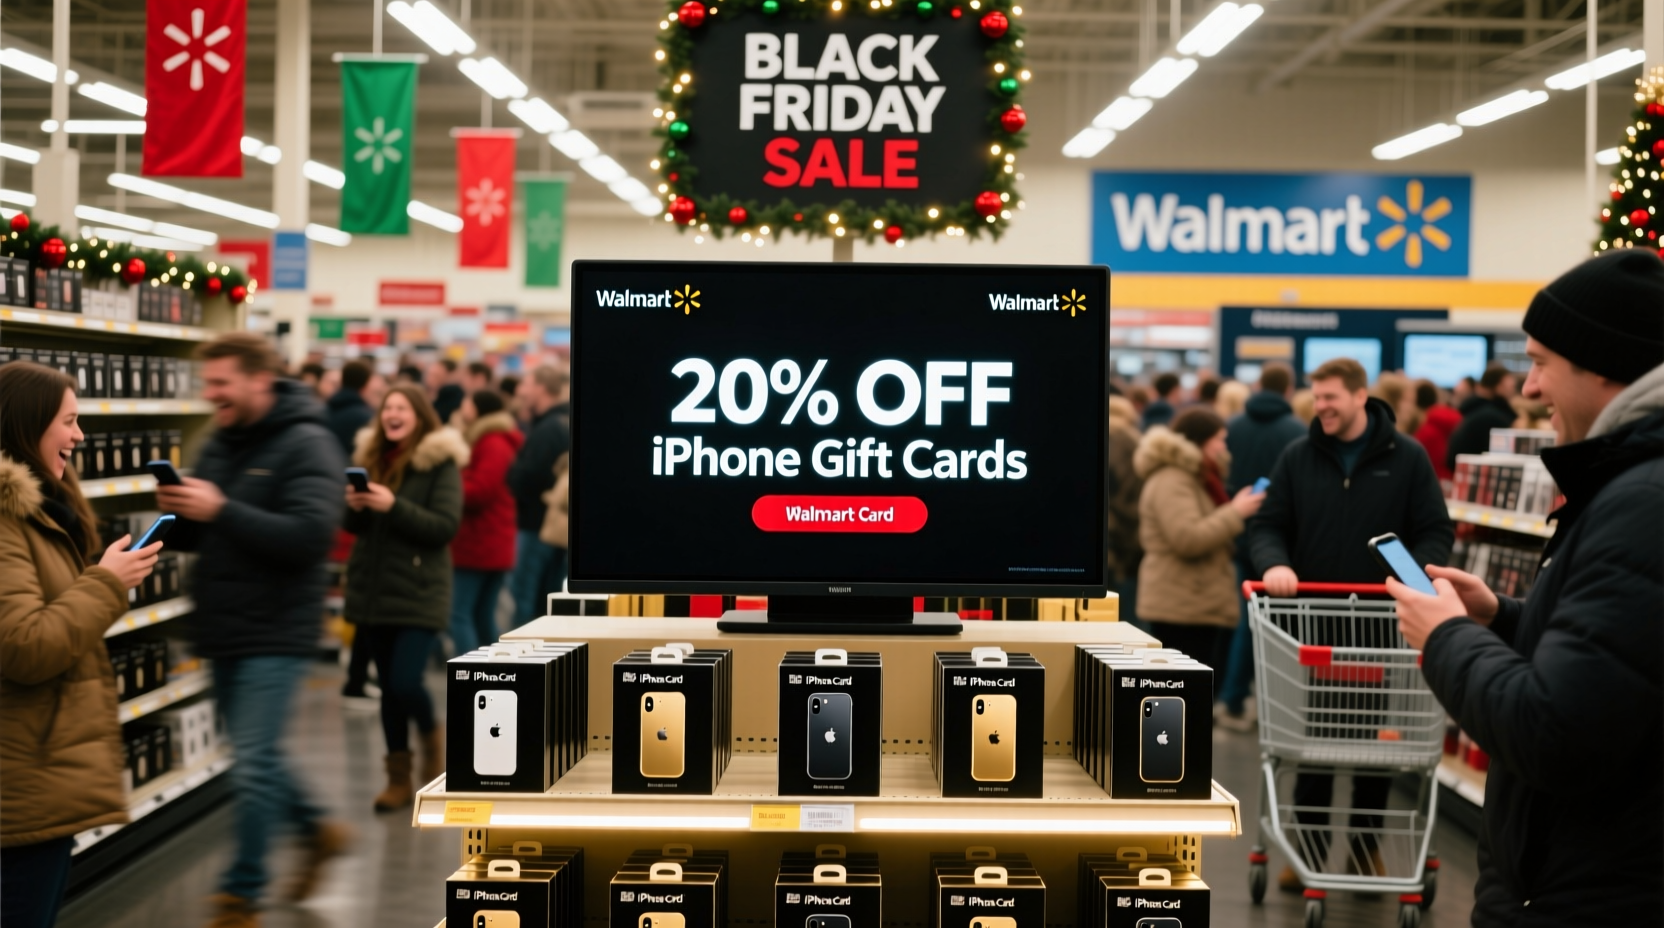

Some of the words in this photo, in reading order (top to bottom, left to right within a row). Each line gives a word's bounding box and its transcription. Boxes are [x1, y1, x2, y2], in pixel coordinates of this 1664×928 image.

[746, 34, 938, 81] BLACK
[740, 84, 945, 132] FRIDAY
[764, 138, 918, 188] SALE
[1113, 195, 1369, 254] Walmart
[596, 289, 671, 307] Walmart
[989, 294, 1059, 310] Walmart
[672, 358, 838, 425] 20%
[857, 360, 1012, 425] OFF
[653, 436, 800, 476] iPhone
[812, 438, 892, 477] Gift
[903, 439, 1027, 479] Cards
[786, 506, 854, 521] Walmart
[859, 507, 893, 521] Card
